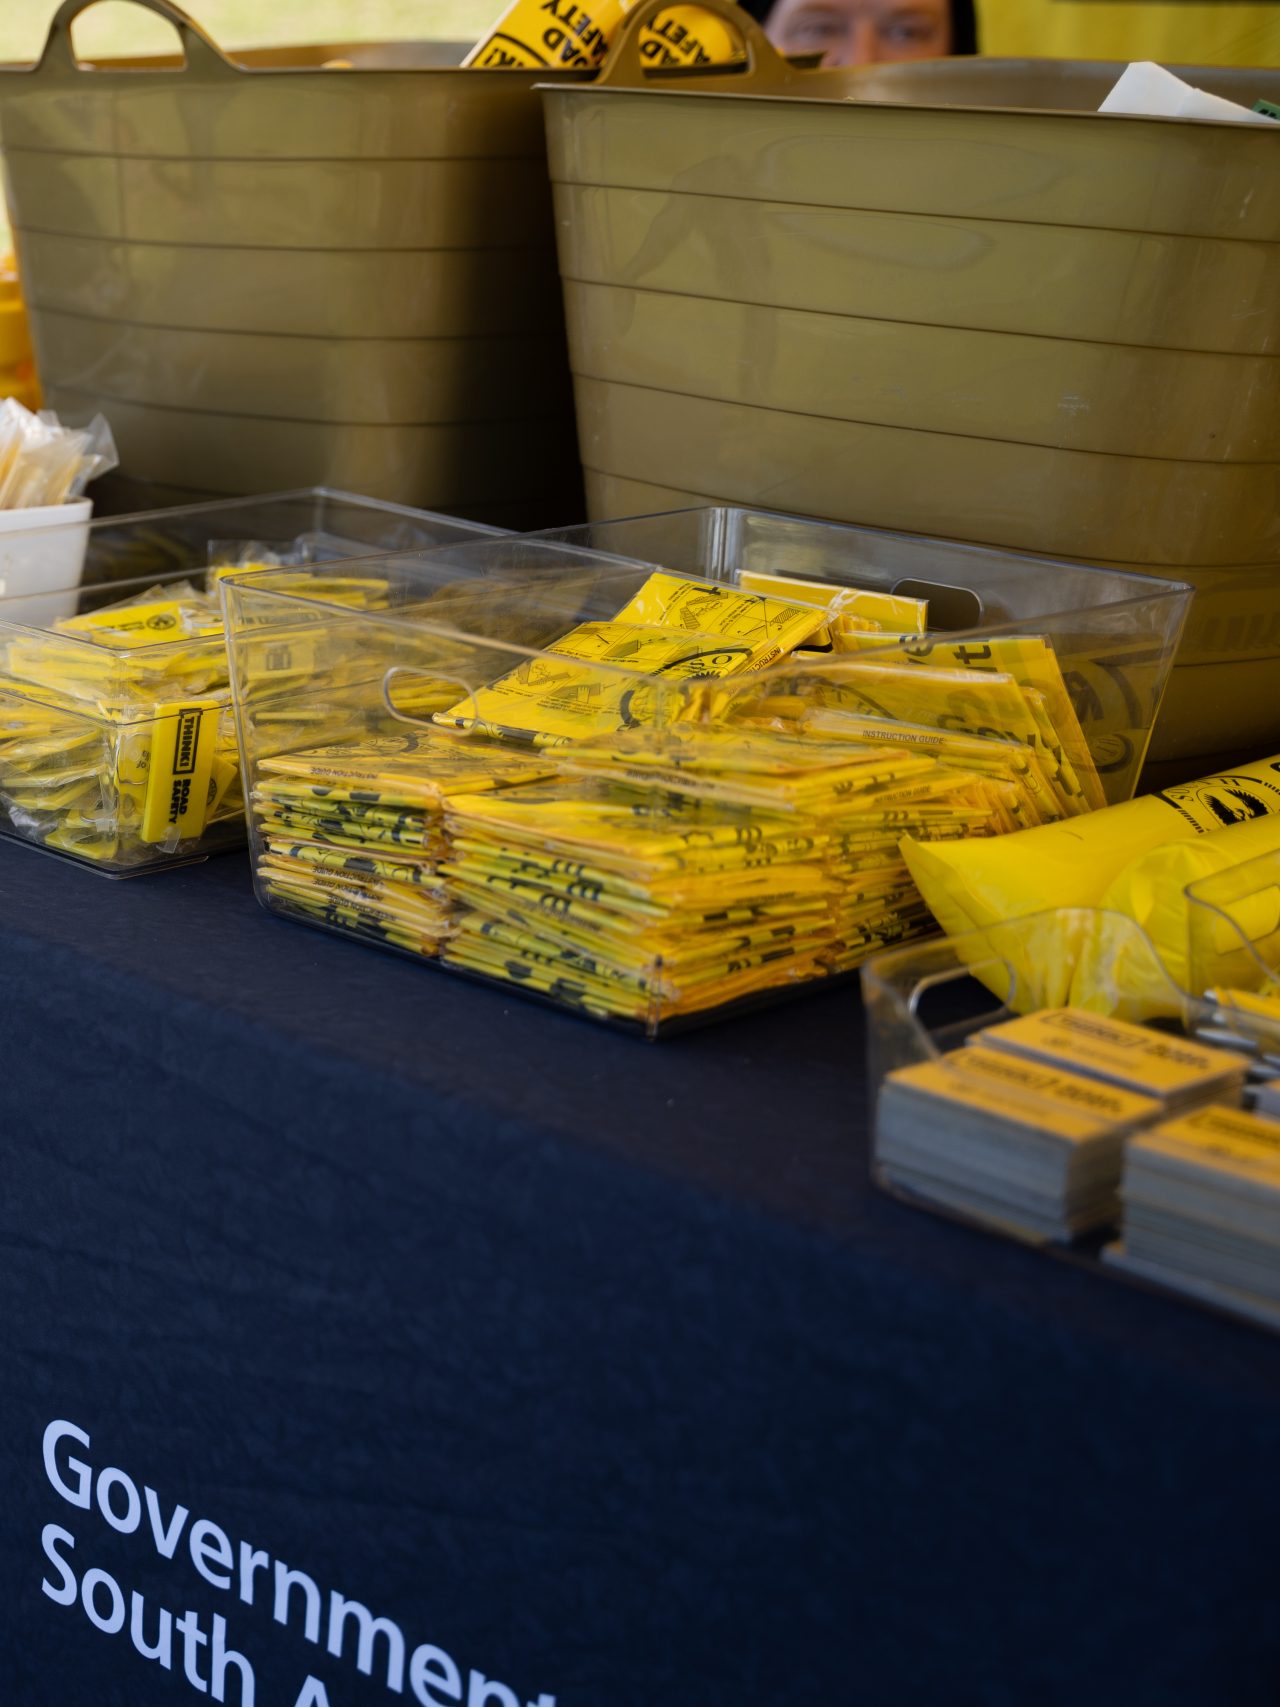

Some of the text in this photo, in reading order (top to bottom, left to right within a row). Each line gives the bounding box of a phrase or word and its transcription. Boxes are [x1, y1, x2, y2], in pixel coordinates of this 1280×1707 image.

[179, 716, 195, 767] THINK!
[862, 729, 945, 744] INSTRUCTION GUIDE
[42, 1419, 557, 1707] Governme
[42, 1523, 255, 1707] South
